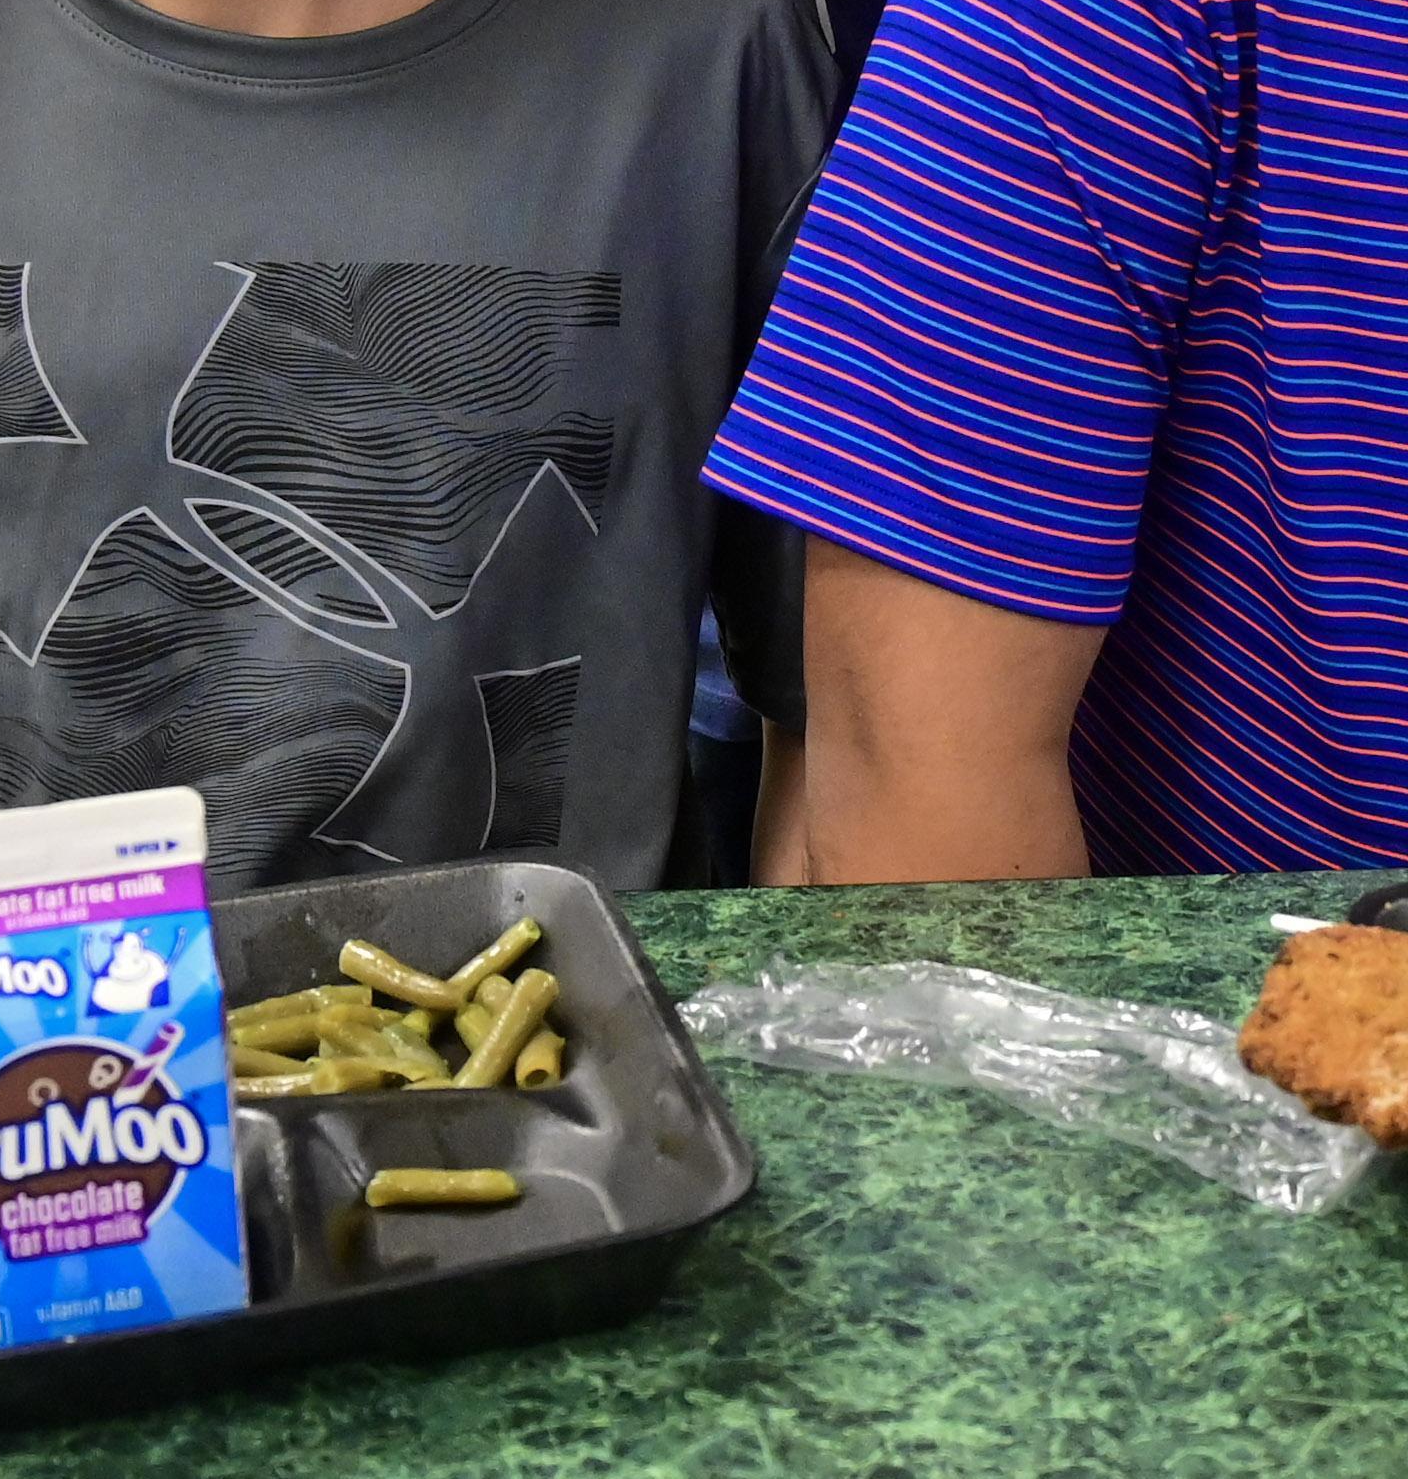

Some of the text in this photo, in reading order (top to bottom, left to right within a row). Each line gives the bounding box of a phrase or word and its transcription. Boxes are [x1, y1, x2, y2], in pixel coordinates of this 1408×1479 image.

[35, 886, 67, 912] fat
[70, 881, 116, 906] free
[117, 871, 166, 901] milk
[0, 1180, 143, 1231] chocolate
[9, 1211, 143, 1258] fat free milk
